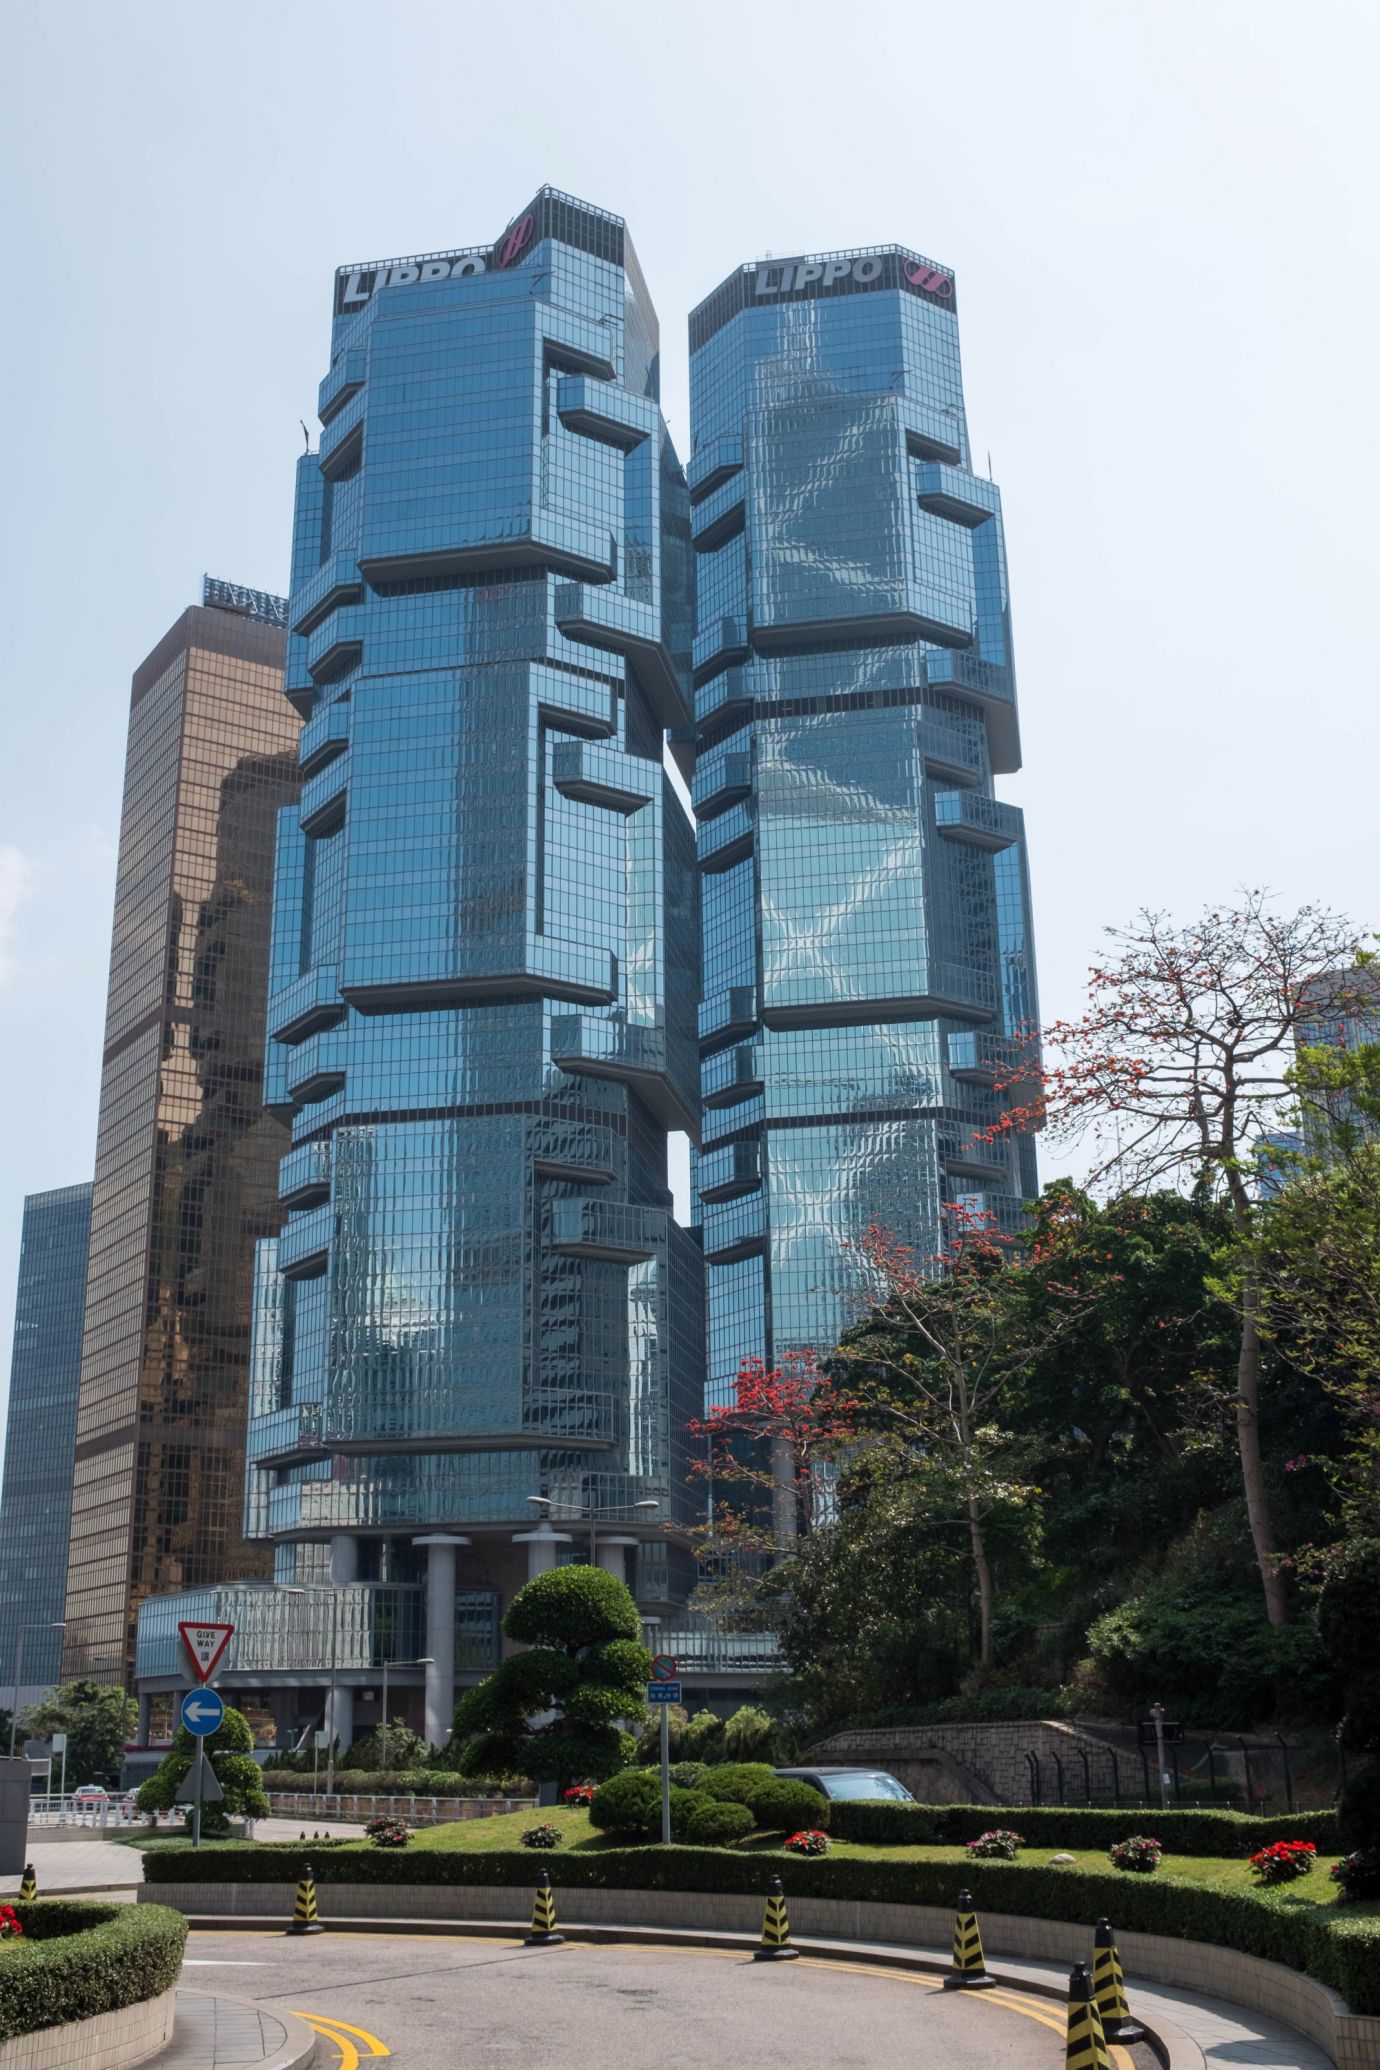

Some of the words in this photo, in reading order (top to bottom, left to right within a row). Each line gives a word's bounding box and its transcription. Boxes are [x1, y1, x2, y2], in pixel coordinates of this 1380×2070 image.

[755, 255, 883, 296] LIPPO
[196, 1630, 216, 1639] GIVE
[197, 1640, 215, 1648] WAY
